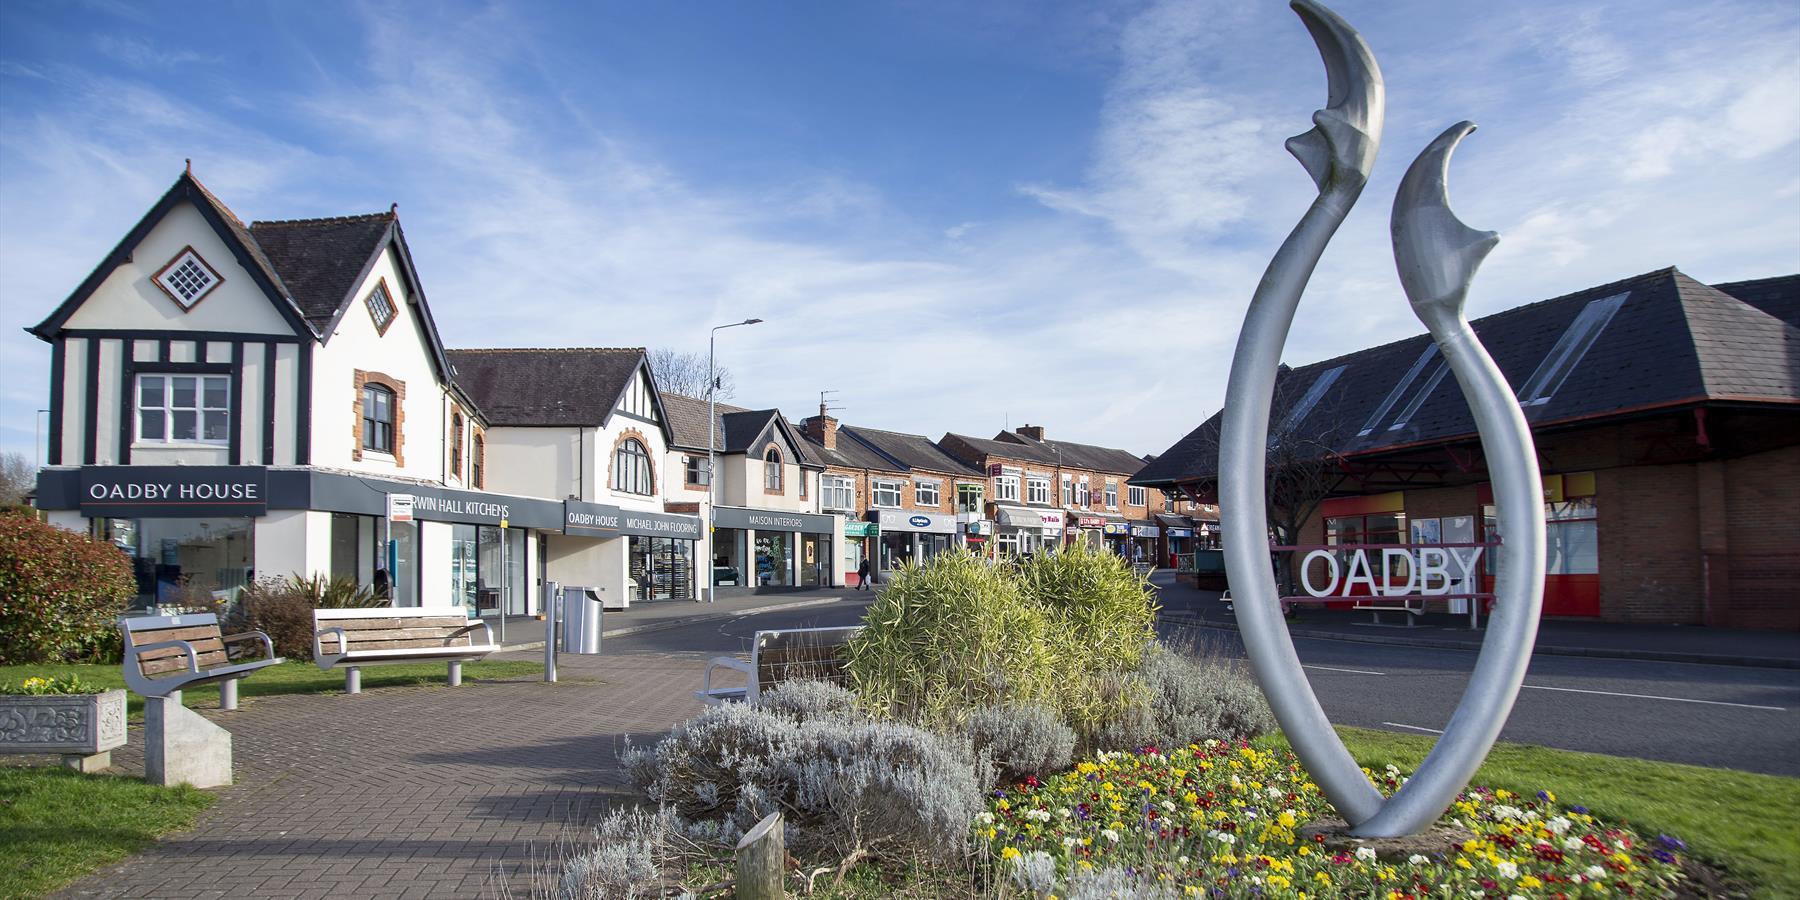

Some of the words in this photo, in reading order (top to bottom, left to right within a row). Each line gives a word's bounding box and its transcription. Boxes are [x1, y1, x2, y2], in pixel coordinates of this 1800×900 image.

[89, 483, 171, 500] OADBY
[179, 484, 258, 500] HOUSE
[411, 495, 437, 511] RWIN
[438, 498, 464, 514] HALL
[465, 501, 509, 518] KITCHENS
[568, 512, 594, 524] OADBY
[595, 516, 618, 528] HOUSE
[626, 518, 652, 531] MICHAEL
[653, 520, 670, 532] JOHN
[670, 522, 697, 534] FLOORING
[749, 515, 773, 526] MAISON
[773, 517, 803, 528] INTERIORS
[1301, 547, 1484, 599] OADBY
